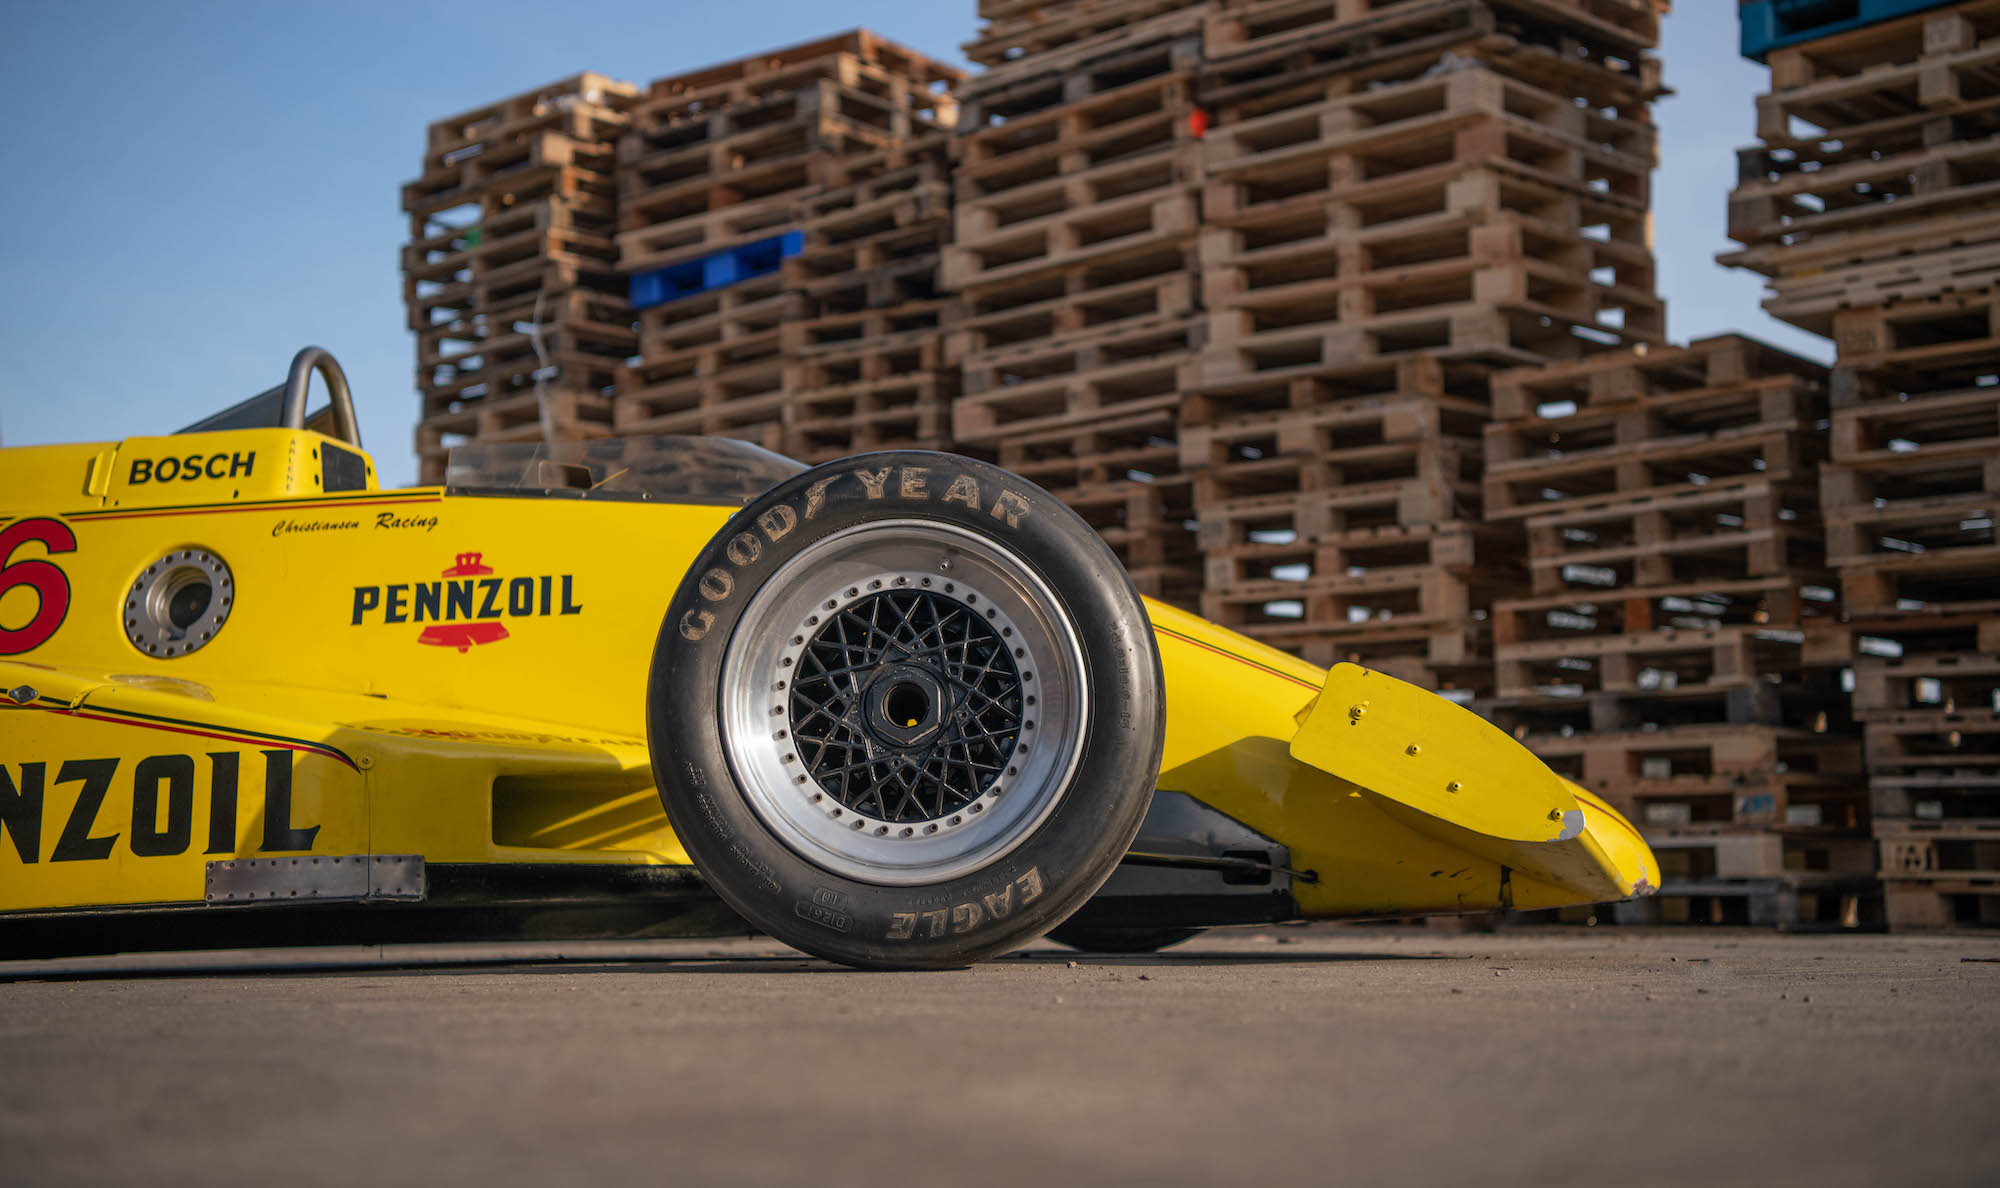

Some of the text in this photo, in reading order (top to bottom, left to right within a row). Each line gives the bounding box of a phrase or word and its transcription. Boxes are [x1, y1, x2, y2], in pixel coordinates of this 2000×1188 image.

[128, 452, 256, 485] BOSCH
[272, 512, 438, 537] Christiansen Racing
[0, 517, 77, 656] 6
[350, 575, 583, 626] PENNZOIL
[886, 865, 1043, 940] EAGLE
